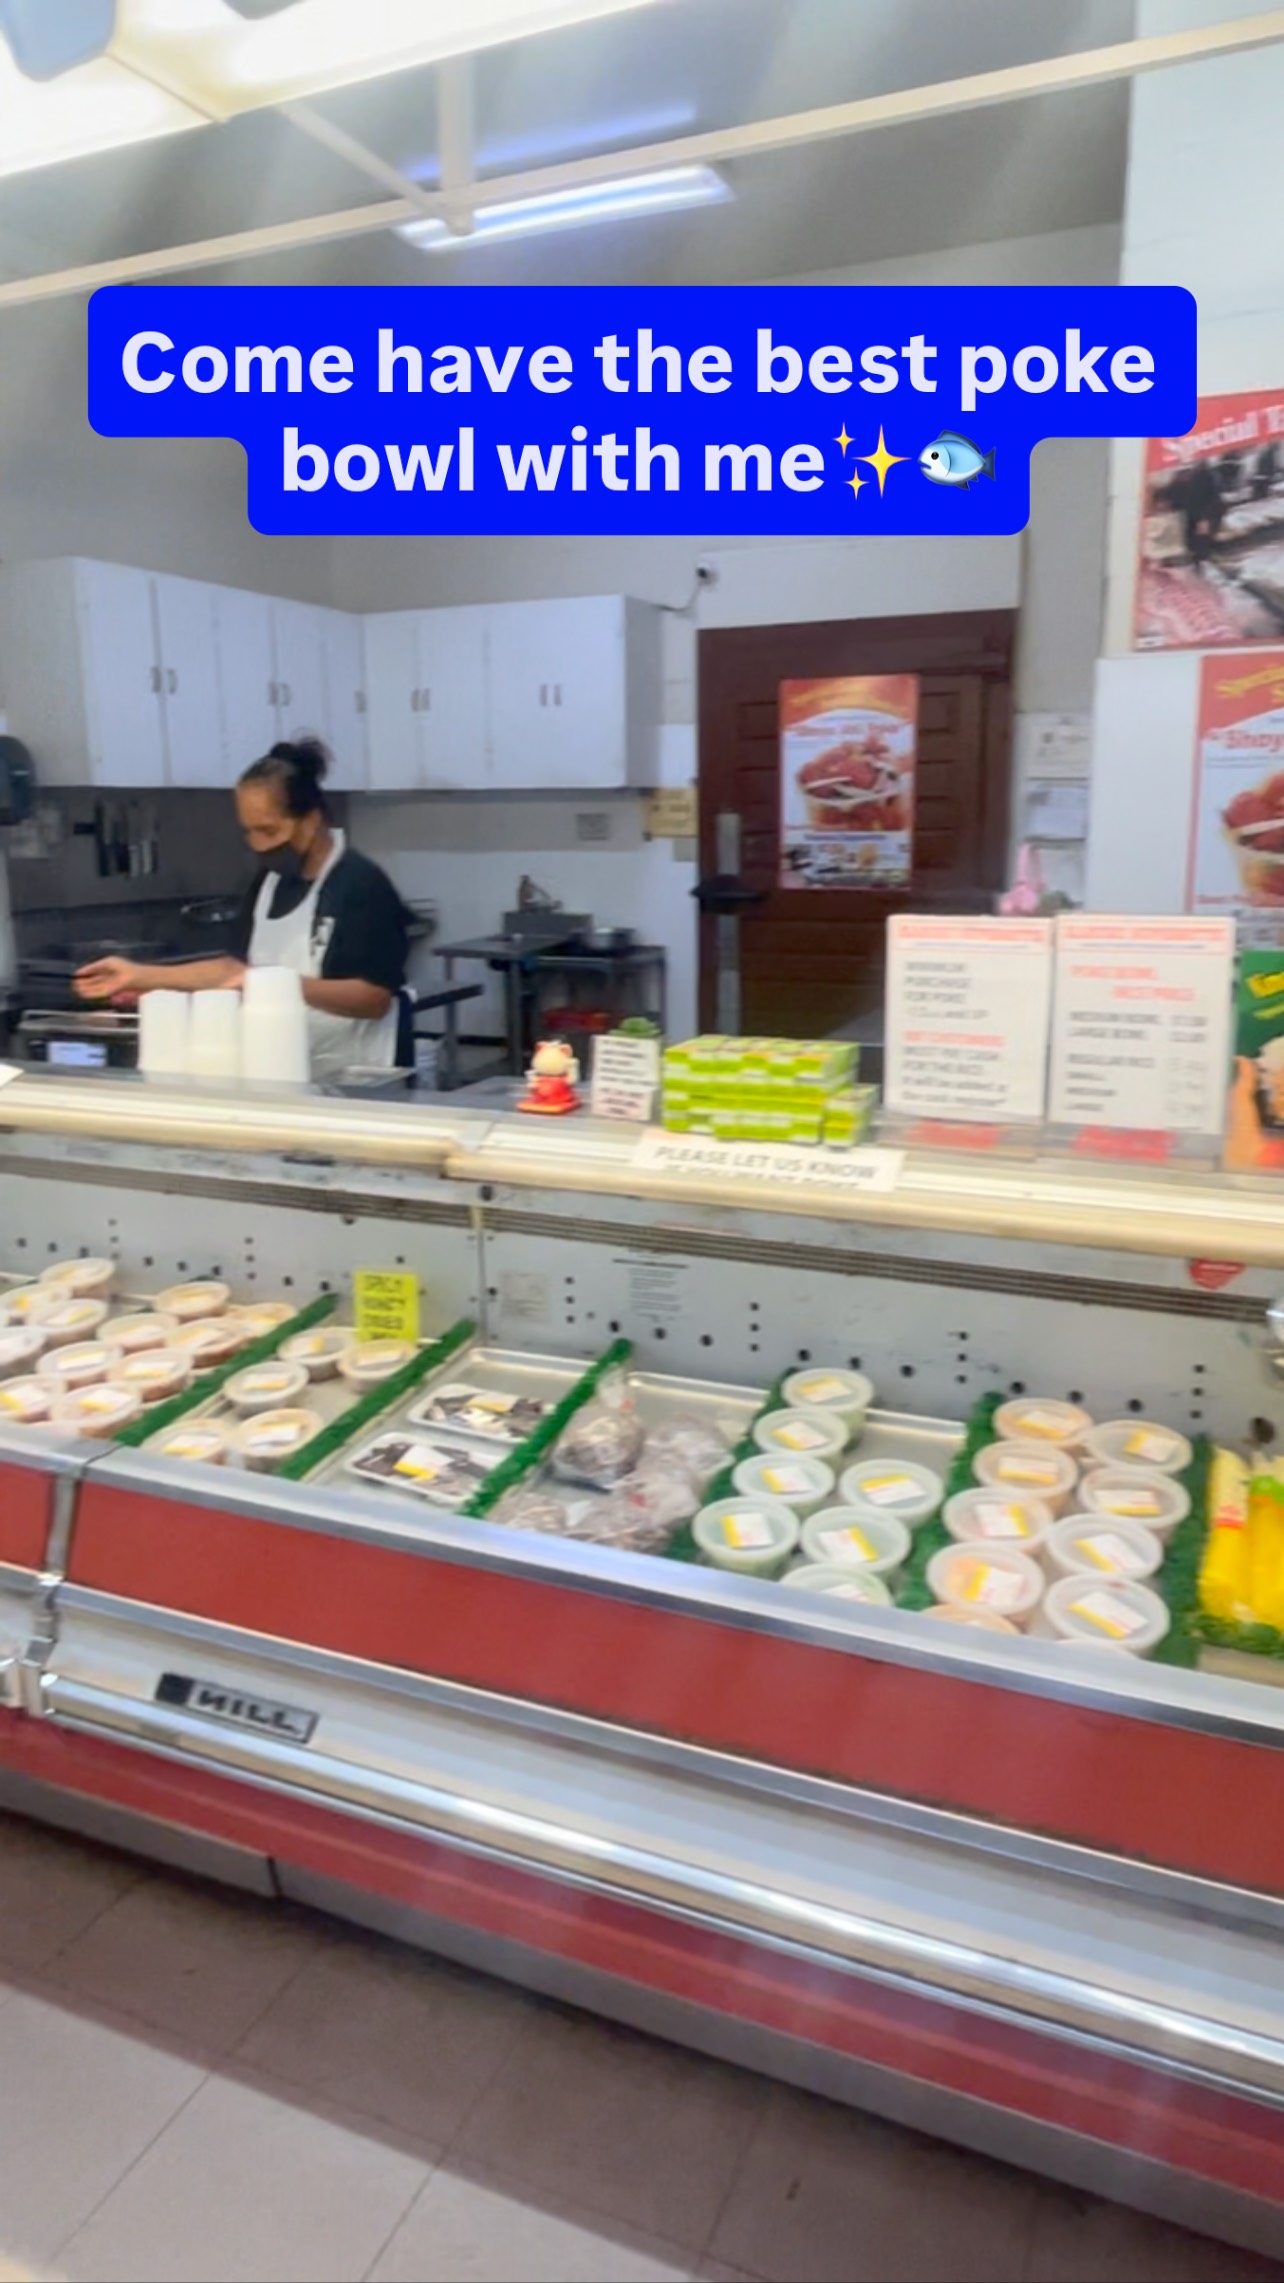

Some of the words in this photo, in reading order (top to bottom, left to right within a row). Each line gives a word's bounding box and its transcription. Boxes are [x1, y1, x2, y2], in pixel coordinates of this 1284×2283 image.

[1160, 411, 1258, 463] Special
[654, 1146, 728, 1165] PLEASE
[732, 1153, 771, 1168] LET
[774, 1158, 803, 1173] US
[807, 1161, 879, 1180] KNOW
[198, 1689, 299, 1734] HILL
